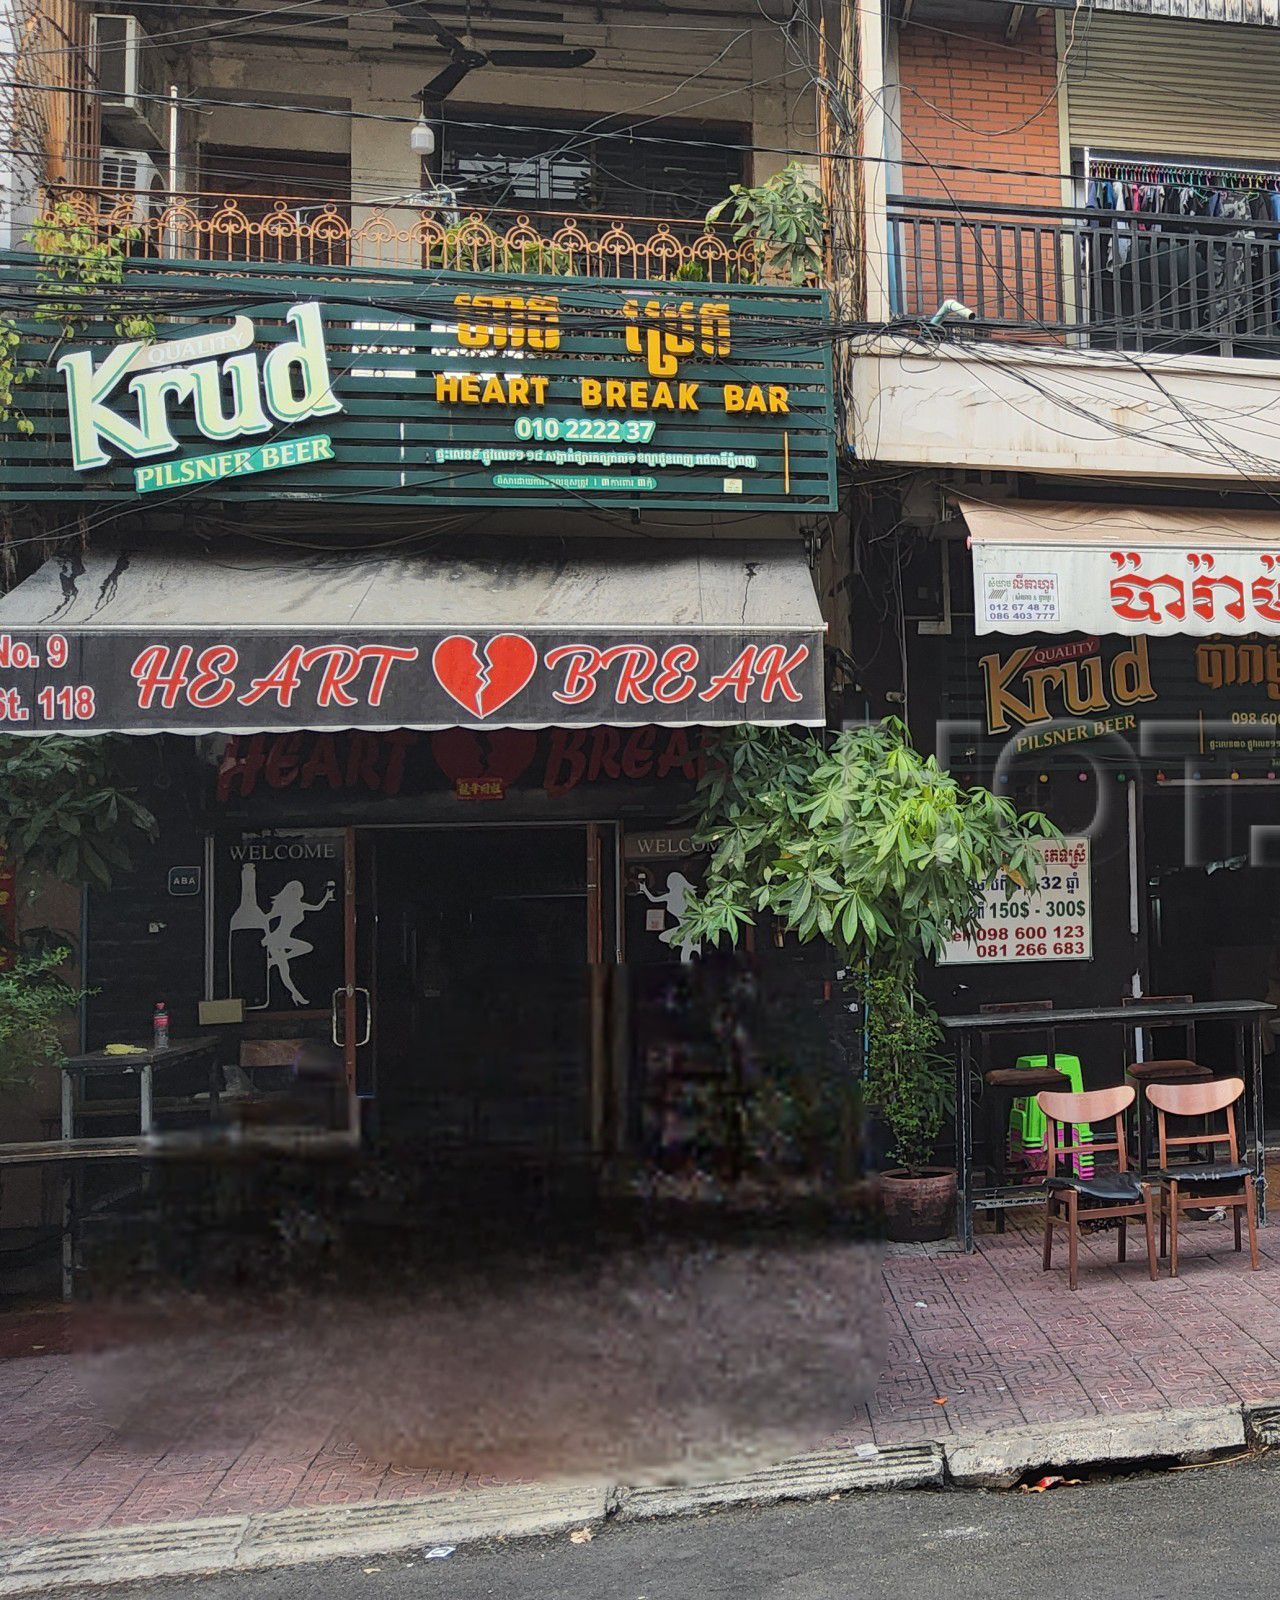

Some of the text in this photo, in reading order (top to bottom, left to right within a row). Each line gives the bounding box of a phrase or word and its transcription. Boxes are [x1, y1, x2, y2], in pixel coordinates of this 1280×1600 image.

[148, 332, 247, 364] QUALITY
[57, 302, 344, 471] Krud
[434, 375, 790, 413] HEART BREAK BAR
[516, 418, 654, 441] 010 2222 37
[136, 437, 335, 490] PILSNER BEER
[989, 603, 1055, 611] 012 67 48 78
[990, 612, 1055, 620] 086 403 777
[47, 634, 68, 668] 9
[1034, 640, 1096, 663] QUALITY
[131, 643, 809, 708] HEART BREAK
[978, 634, 1158, 736] Krud
[38, 686, 95, 719] 118
[1231, 712, 1257, 726] 098
[1017, 715, 1136, 752] PILSNER BEER
[216, 725, 735, 800] HEART BREA
[230, 843, 336, 861] WELCOME
[637, 838, 722, 854] WELCOM
[173, 877, 195, 885] ABA
[989, 901, 1029, 920] 150$
[1046, 900, 1086, 918] 300$
[976, 928, 1009, 942] 098
[1015, 926, 1047, 940] 600
[1054, 925, 1085, 939] 123
[976, 942, 1085, 958] 081 266 683
